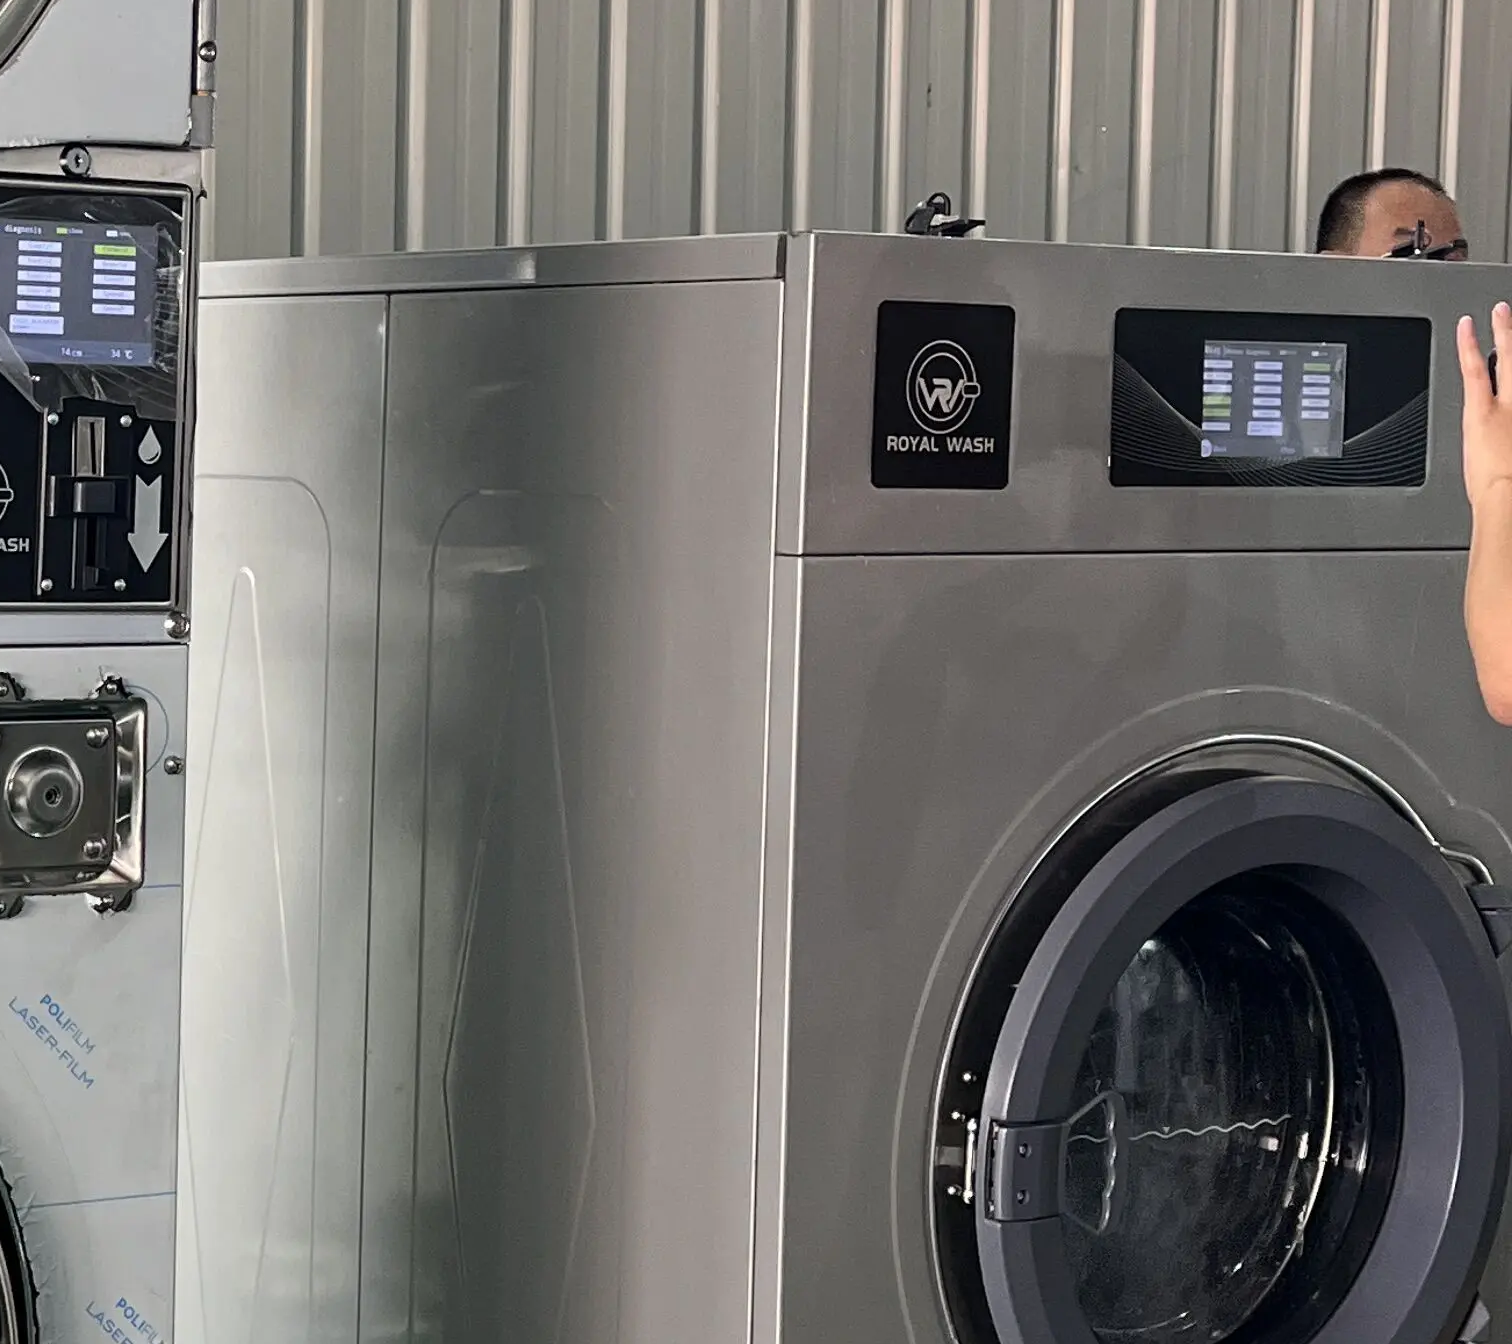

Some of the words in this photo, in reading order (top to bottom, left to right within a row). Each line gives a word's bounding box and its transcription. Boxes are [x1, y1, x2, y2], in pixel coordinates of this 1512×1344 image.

[4, 224, 43, 235] diagnosis
[886, 435, 940, 453] ROYAL
[946, 436, 995, 454] WASH
[7, 995, 95, 1090] LASER-FILM
[39, 993, 96, 1055] POLIFILM
